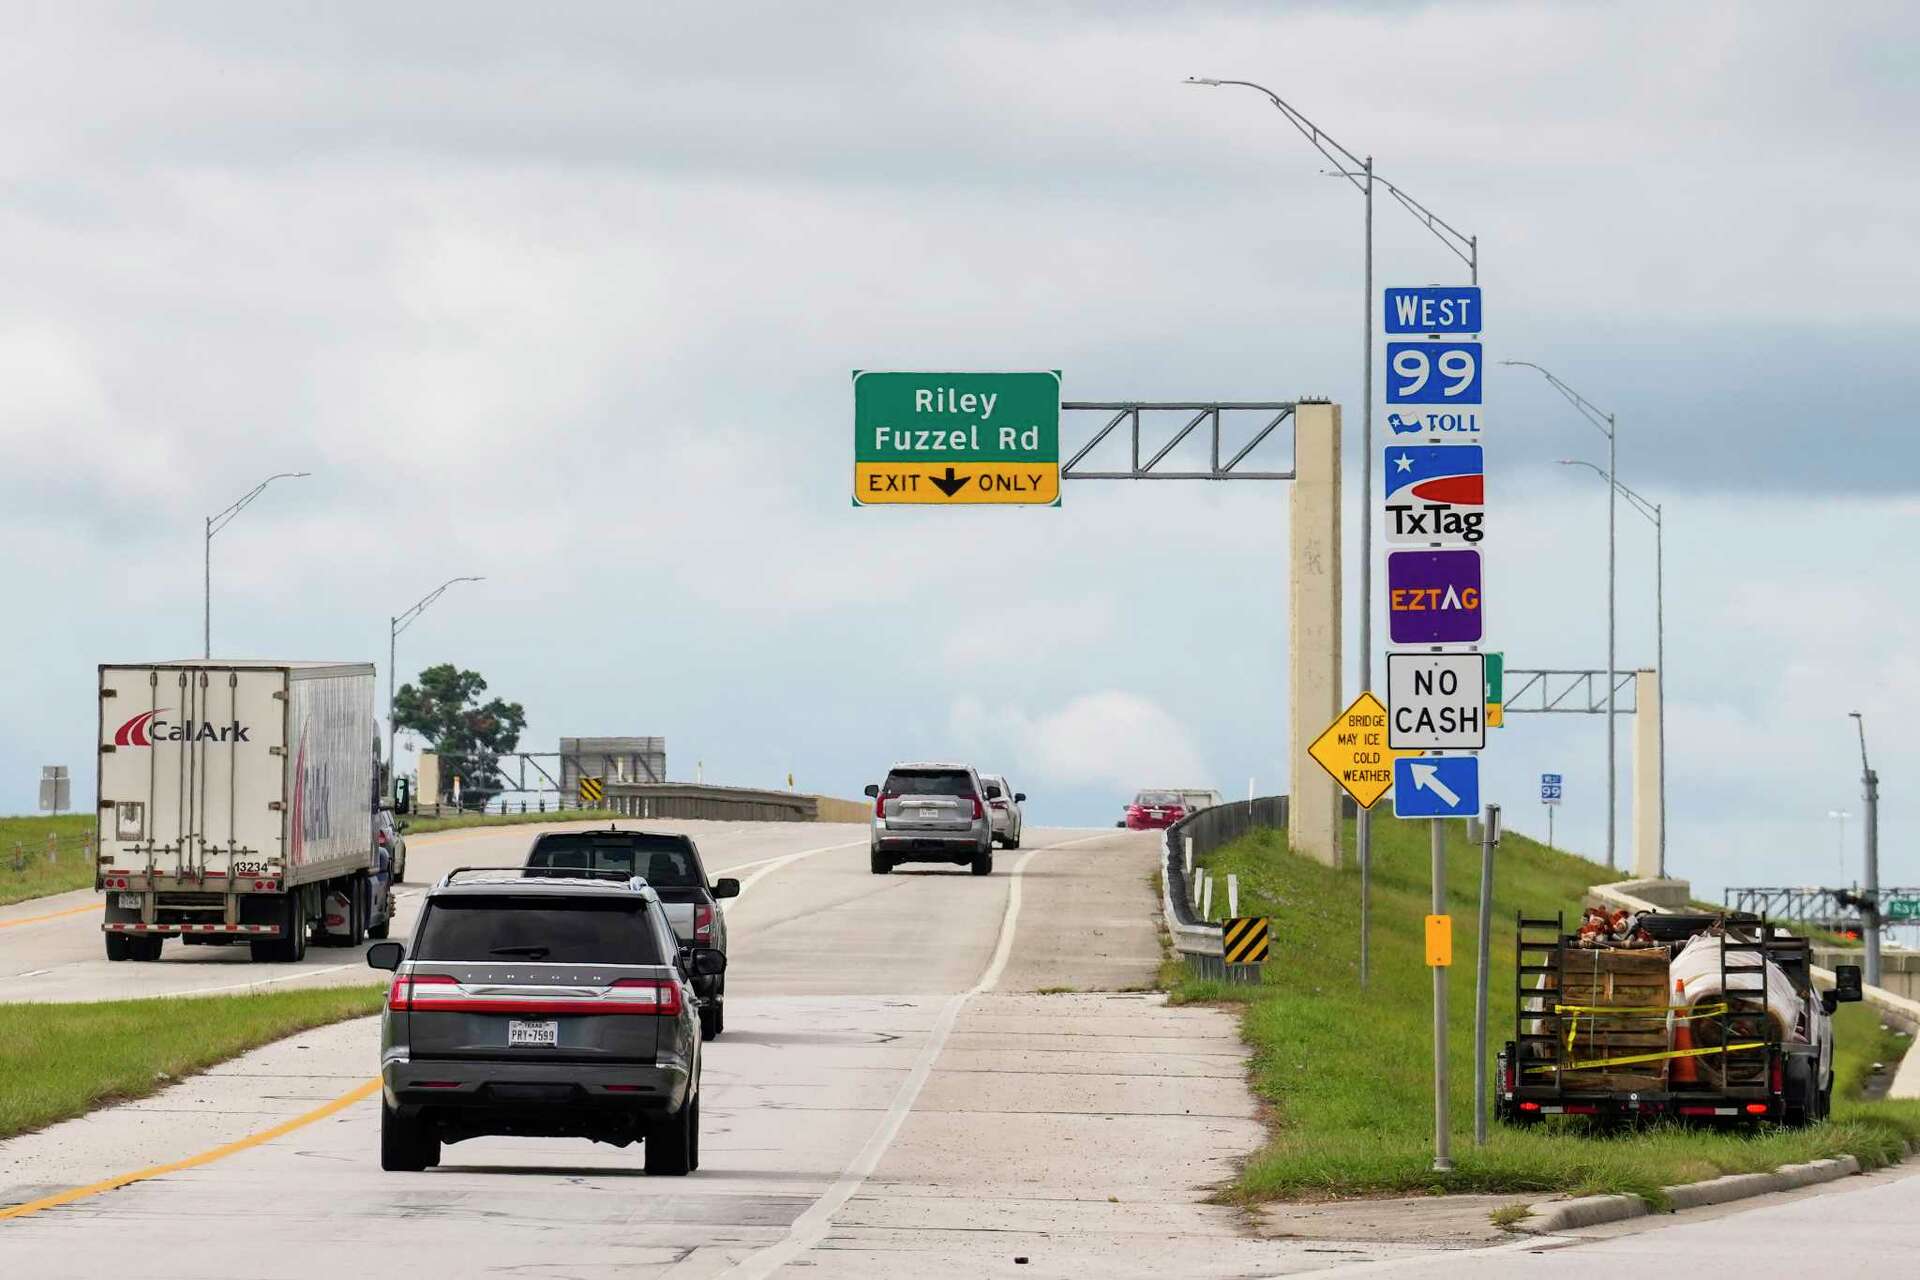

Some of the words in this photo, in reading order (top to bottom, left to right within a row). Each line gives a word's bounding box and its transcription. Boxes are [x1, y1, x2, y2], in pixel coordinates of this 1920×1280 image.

[1395, 294, 1471, 326] WEST
[1392, 349, 1475, 397] 99
[915, 387, 997, 420] Riley
[1426, 413, 1480, 432] TOLL
[875, 425, 980, 451] Fuzzel
[999, 425, 1039, 451] Rd
[869, 474, 921, 491] EXIT
[978, 474, 1042, 491] ONLY
[1385, 504, 1484, 543] TxTag
[1391, 584, 1479, 611] EZTAG
[1414, 669, 1458, 696] NO
[1348, 714, 1385, 728] BRIDGE
[1395, 706, 1479, 734] CASH
[1338, 733, 1358, 746] MAY
[1364, 733, 1381, 746] ICE
[1353, 751, 1381, 765] COLD
[1343, 770, 1391, 782] WEATHER
[1542, 786, 1560, 798] 99
[235, 861, 269, 873] 13234
